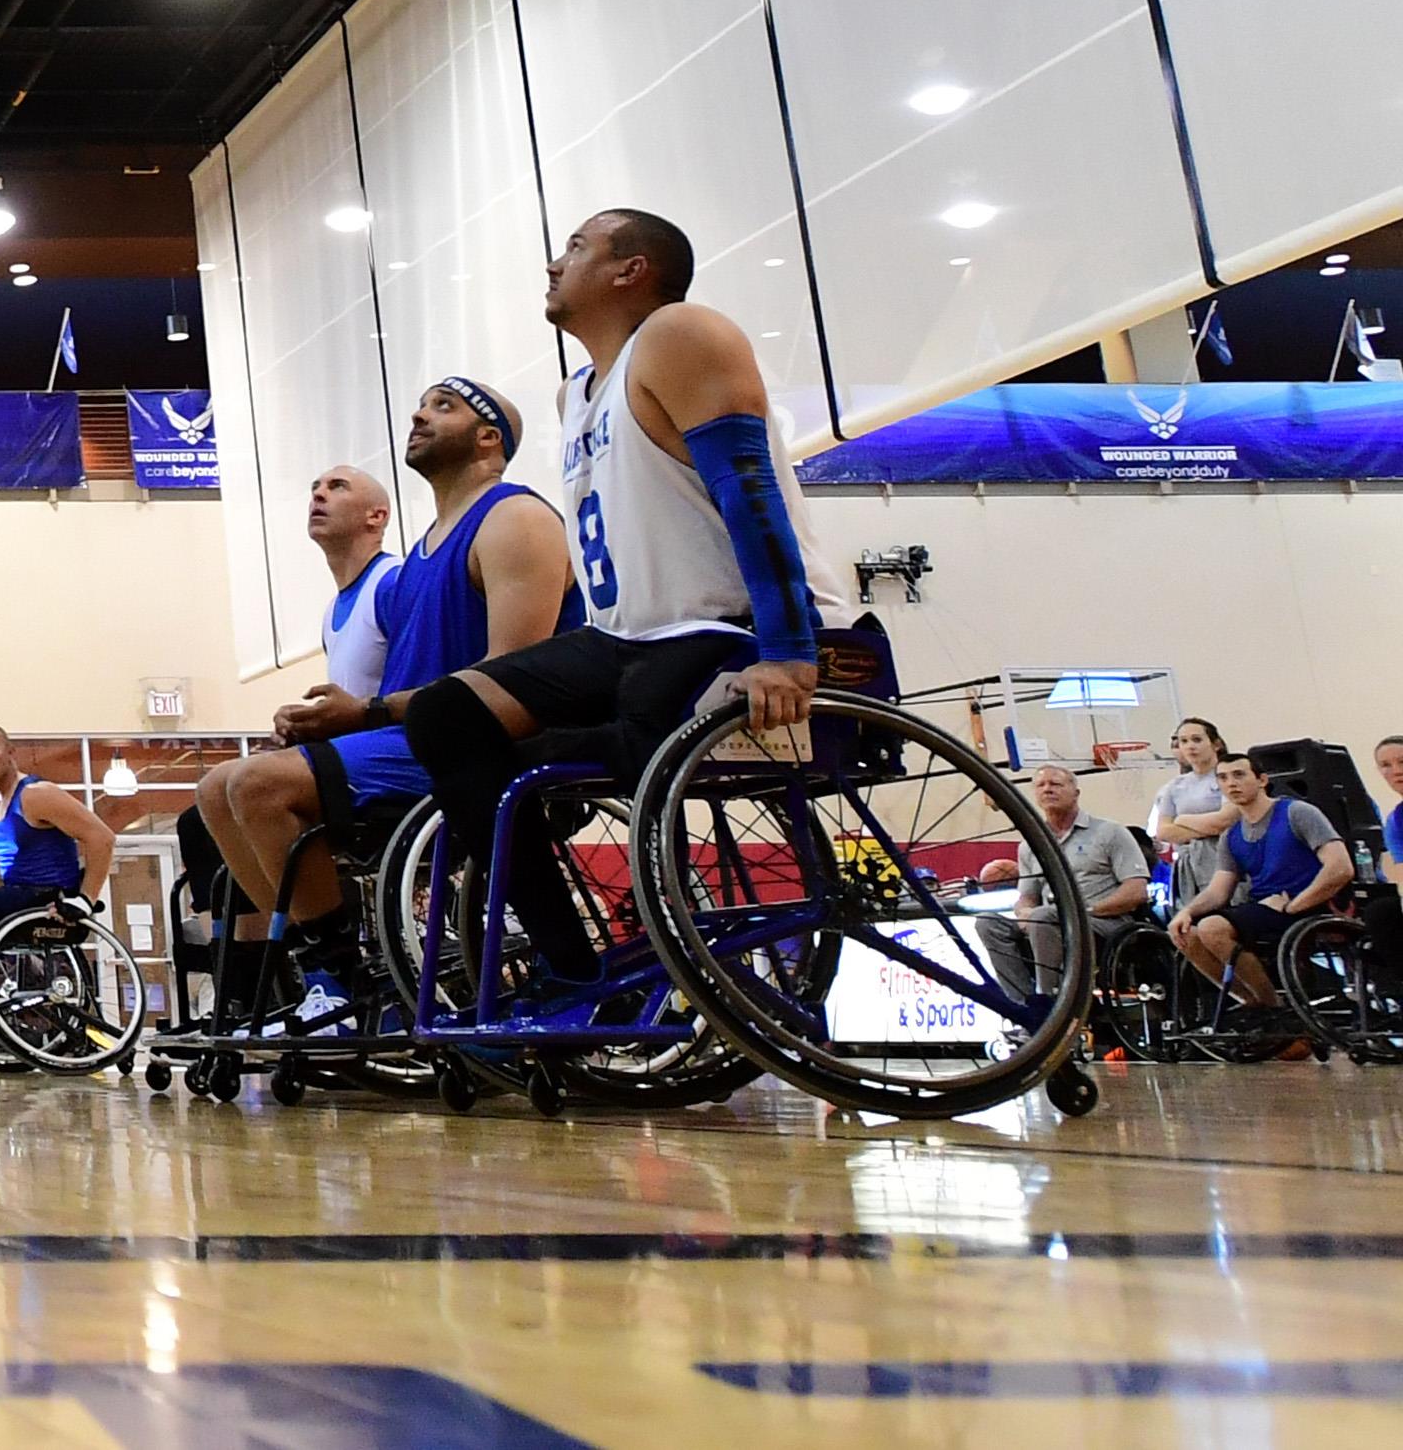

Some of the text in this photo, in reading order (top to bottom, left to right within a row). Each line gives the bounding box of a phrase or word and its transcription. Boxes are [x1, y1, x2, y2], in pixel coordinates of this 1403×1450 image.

[135, 452, 195, 462] WOUNDED
[1100, 450, 1237, 461] WOUNDED WARRIOR
[1115, 464, 1229, 478] carebeyondduty
[577, 489, 619, 610] 8
[153, 695, 179, 714] EXIT
[899, 997, 976, 1034] & Sports
